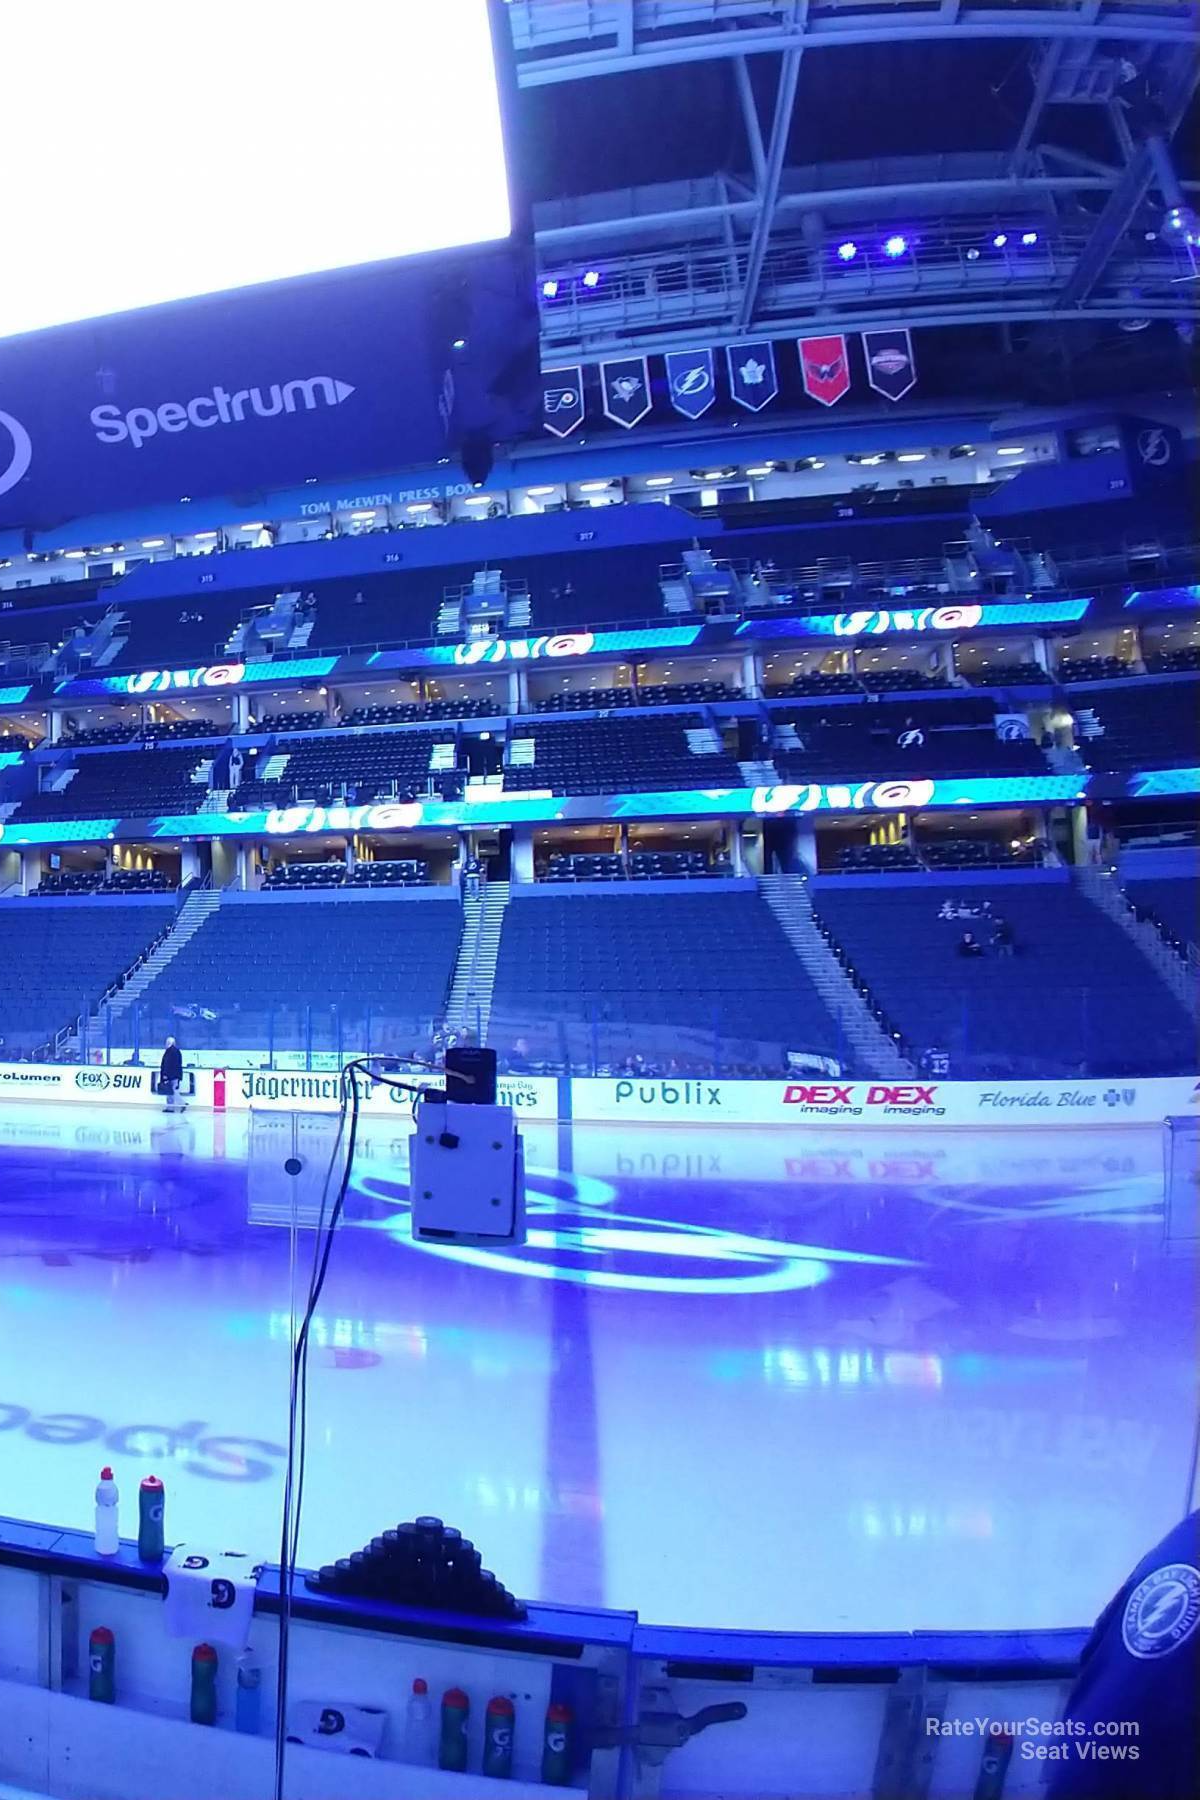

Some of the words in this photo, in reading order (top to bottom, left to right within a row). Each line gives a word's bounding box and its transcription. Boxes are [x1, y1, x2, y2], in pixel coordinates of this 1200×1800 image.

[90, 376, 338, 449] Spectrum
[300, 502, 331, 516] TOM
[336, 493, 393, 511] McEWEN
[400, 487, 440, 503] PRESS
[446, 483, 475, 497] BOX
[82, 1073, 103, 1084] FOX
[112, 1074, 142, 1089] SUN
[615, 1080, 722, 1106] Publix
[783, 1085, 856, 1105] DEX
[866, 1086, 939, 1106] DEX
[978, 1090, 1052, 1108] Florida
[1055, 1091, 1097, 1108] Blue
[800, 1104, 863, 1116] imaging
[883, 1104, 946, 1117] imaging
[492, 1728, 510, 1746] G
[547, 1732, 566, 1752] G
